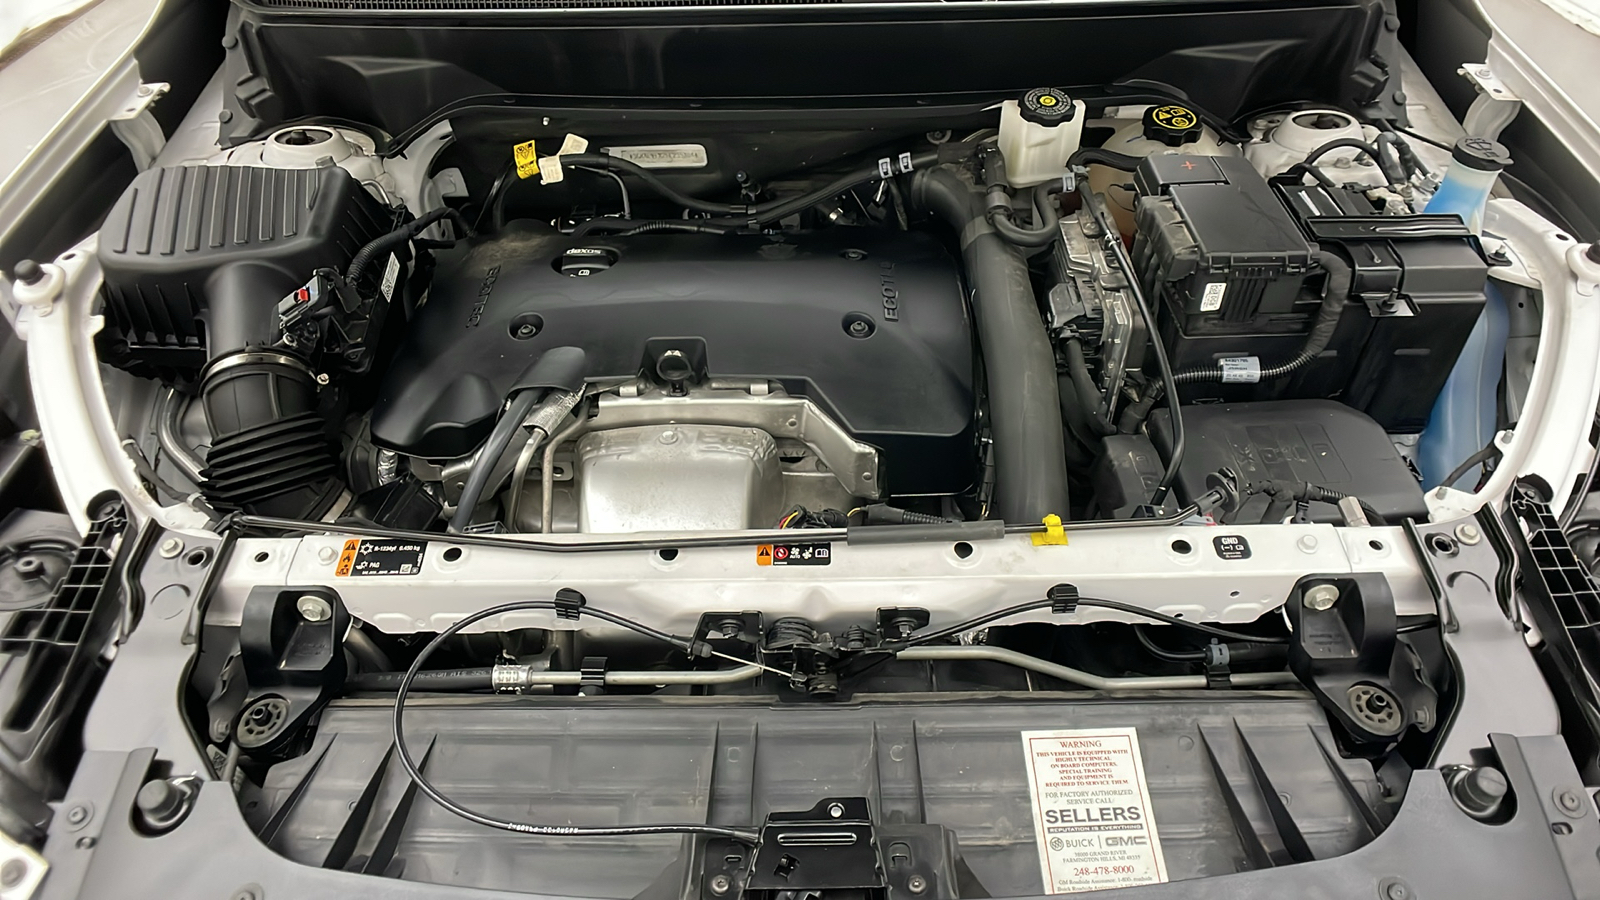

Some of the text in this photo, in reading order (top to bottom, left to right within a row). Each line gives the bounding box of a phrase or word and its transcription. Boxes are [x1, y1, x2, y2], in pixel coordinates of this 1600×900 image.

[1059, 740, 1102, 748] WARNING
[1090, 789, 1134, 797] AUTHORIZED
[1045, 806, 1141, 824] SELLERS
[1065, 836, 1147, 848] BUICK GMC
[1073, 865, 1135, 876] 248-478-8000
